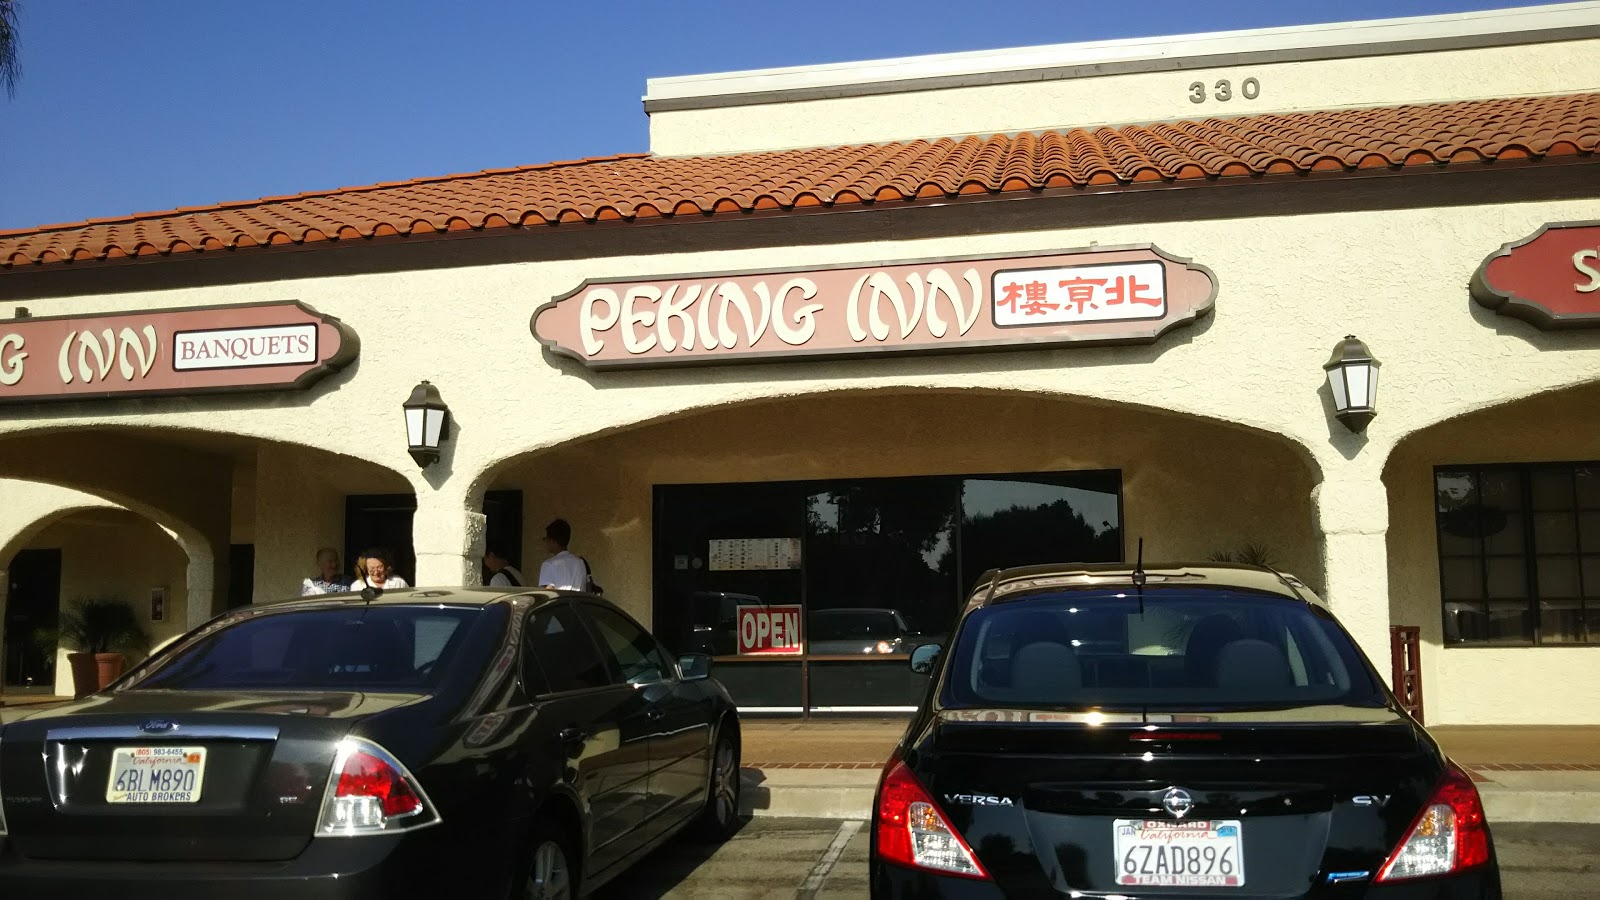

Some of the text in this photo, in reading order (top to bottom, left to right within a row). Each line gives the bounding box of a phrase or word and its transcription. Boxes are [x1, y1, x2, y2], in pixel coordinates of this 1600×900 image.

[1189, 77, 1260, 104] 330
[580, 267, 983, 356] PEKING INN
[58, 325, 158, 384] INN
[180, 334, 311, 362] BANQUETS
[741, 612, 799, 649] OPEN
[145, 719, 170, 729] Ford
[153, 748, 184, 756] 983-6455
[132, 756, 187, 768] California
[115, 769, 195, 792] 6BLM890
[126, 792, 149, 801] AUTO
[151, 792, 191, 801] BROKERS
[944, 793, 1014, 807] VERSA
[1352, 794, 1392, 807] SV
[1121, 827, 1136, 836] JAN
[1140, 829, 1218, 844] California
[1123, 845, 1233, 875] 6ZAD896
[1136, 875, 1227, 885] TEAM NISSAN
